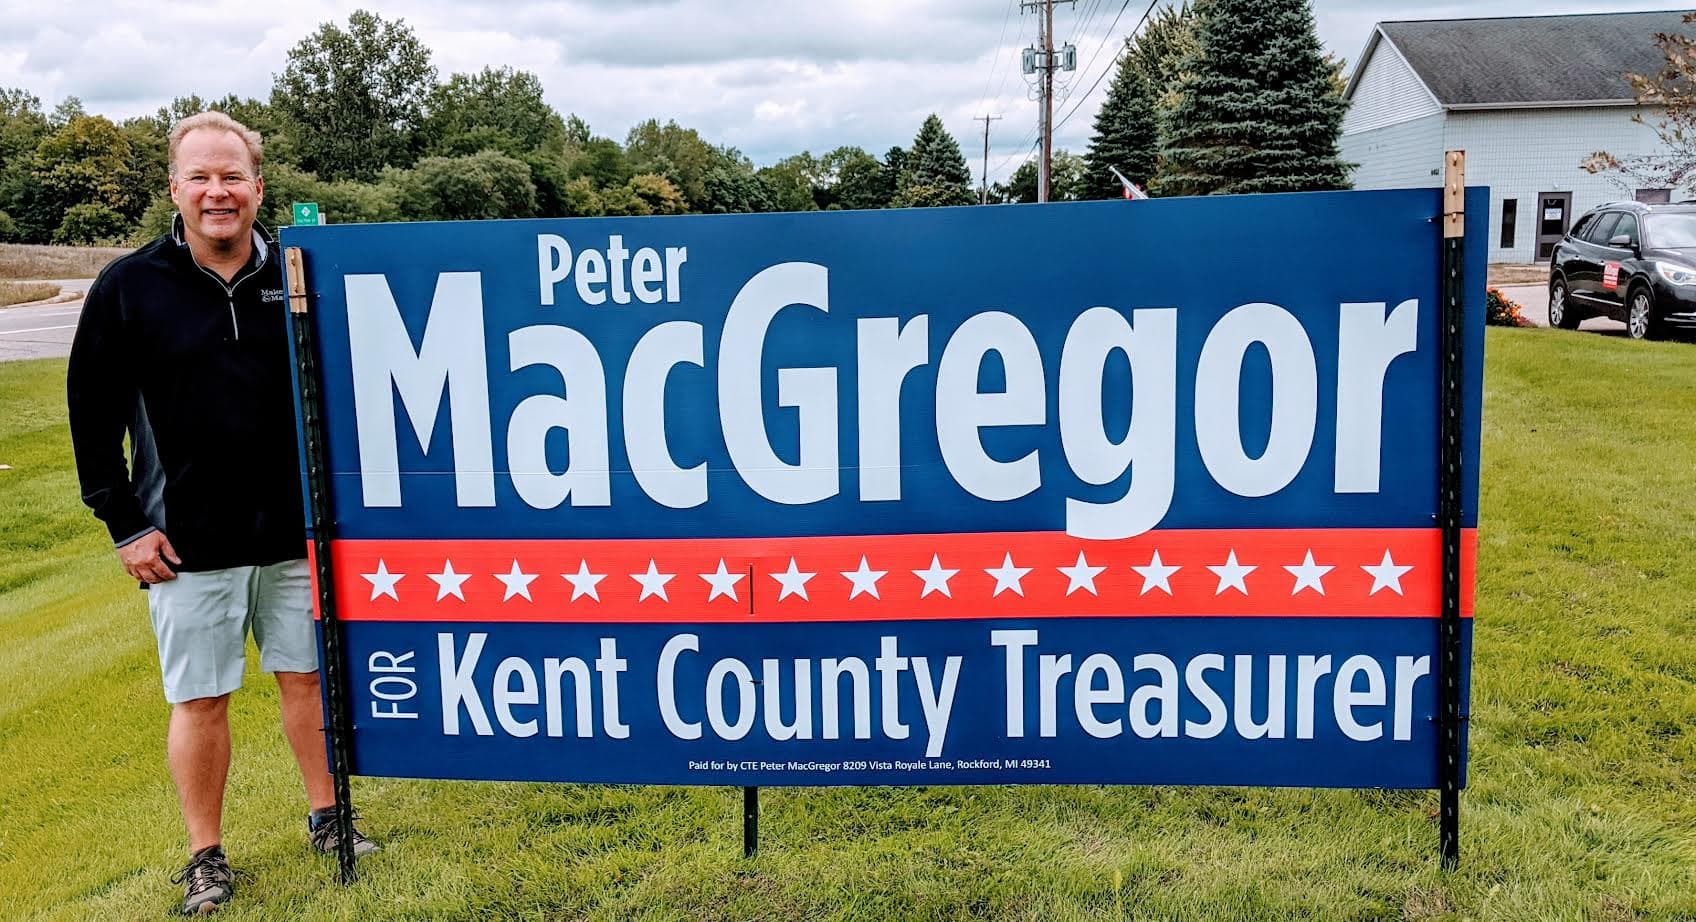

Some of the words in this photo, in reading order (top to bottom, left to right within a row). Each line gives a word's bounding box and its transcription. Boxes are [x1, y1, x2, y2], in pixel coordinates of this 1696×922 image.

[538, 233, 687, 306] Peter
[344, 262, 1418, 540] MacGregor
[369, 651, 418, 719] FOR
[437, 632, 631, 740] Kent
[657, 634, 963, 757] County
[991, 629, 1431, 742] Treasurer
[688, 760, 709, 771] Paid
[710, 760, 724, 771] for
[726, 761, 738, 773] by
[740, 761, 758, 771] CTE
[760, 761, 786, 771] Peter
[788, 761, 841, 773] MacGregor
[842, 761, 867, 771] 8209
[869, 761, 893, 771] Vista
[895, 760, 926, 773] Royale
[928, 759, 954, 771] Lane,
[956, 759, 1002, 771] Rockford,
[1005, 759, 1018, 770] MI
[1020, 759, 1050, 770] 49341
